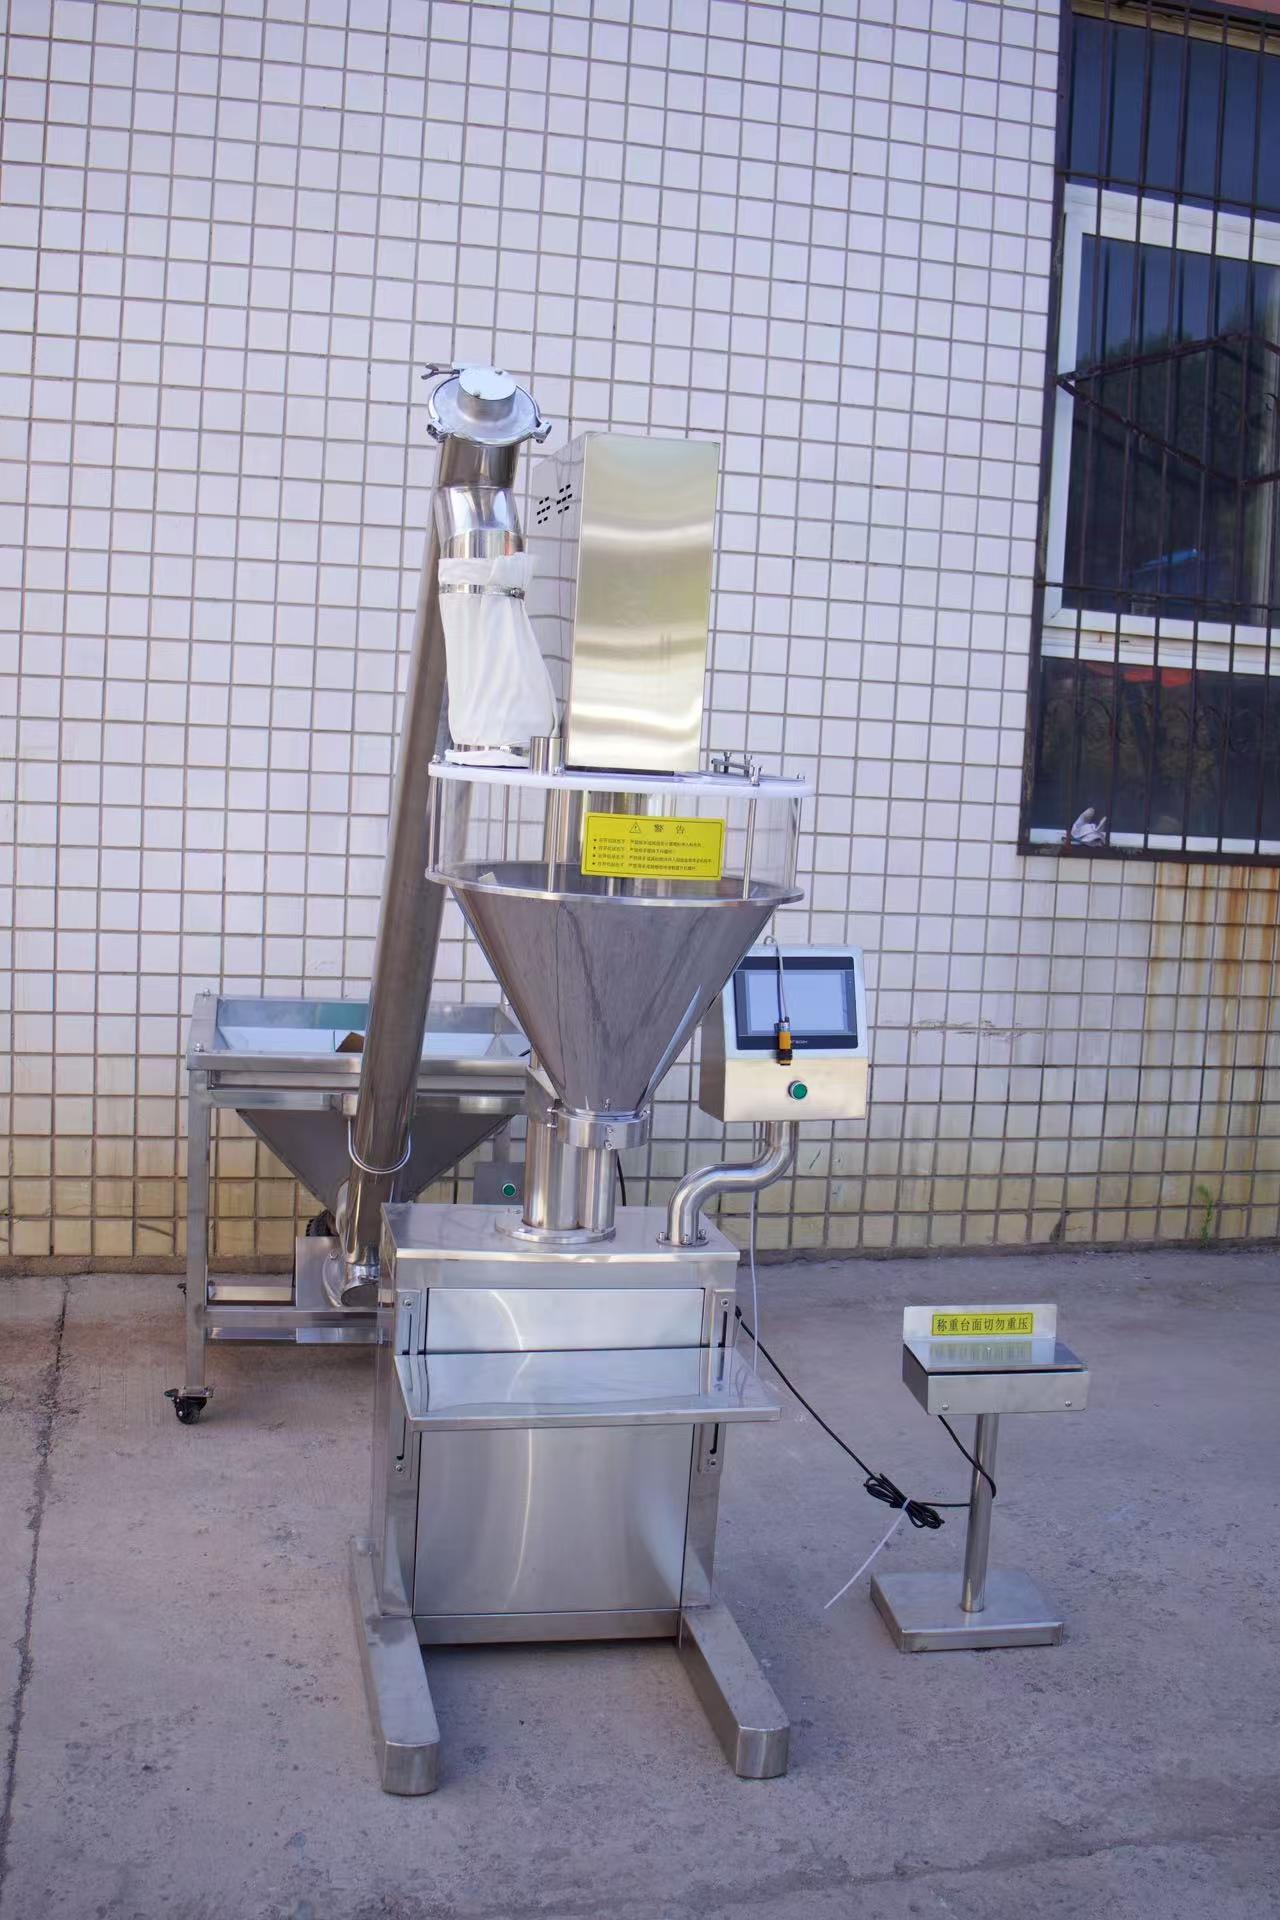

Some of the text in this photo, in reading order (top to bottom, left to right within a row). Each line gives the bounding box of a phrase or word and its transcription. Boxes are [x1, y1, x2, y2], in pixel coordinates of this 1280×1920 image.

[937, 1317, 1029, 1332] 称重台面切勿重压
